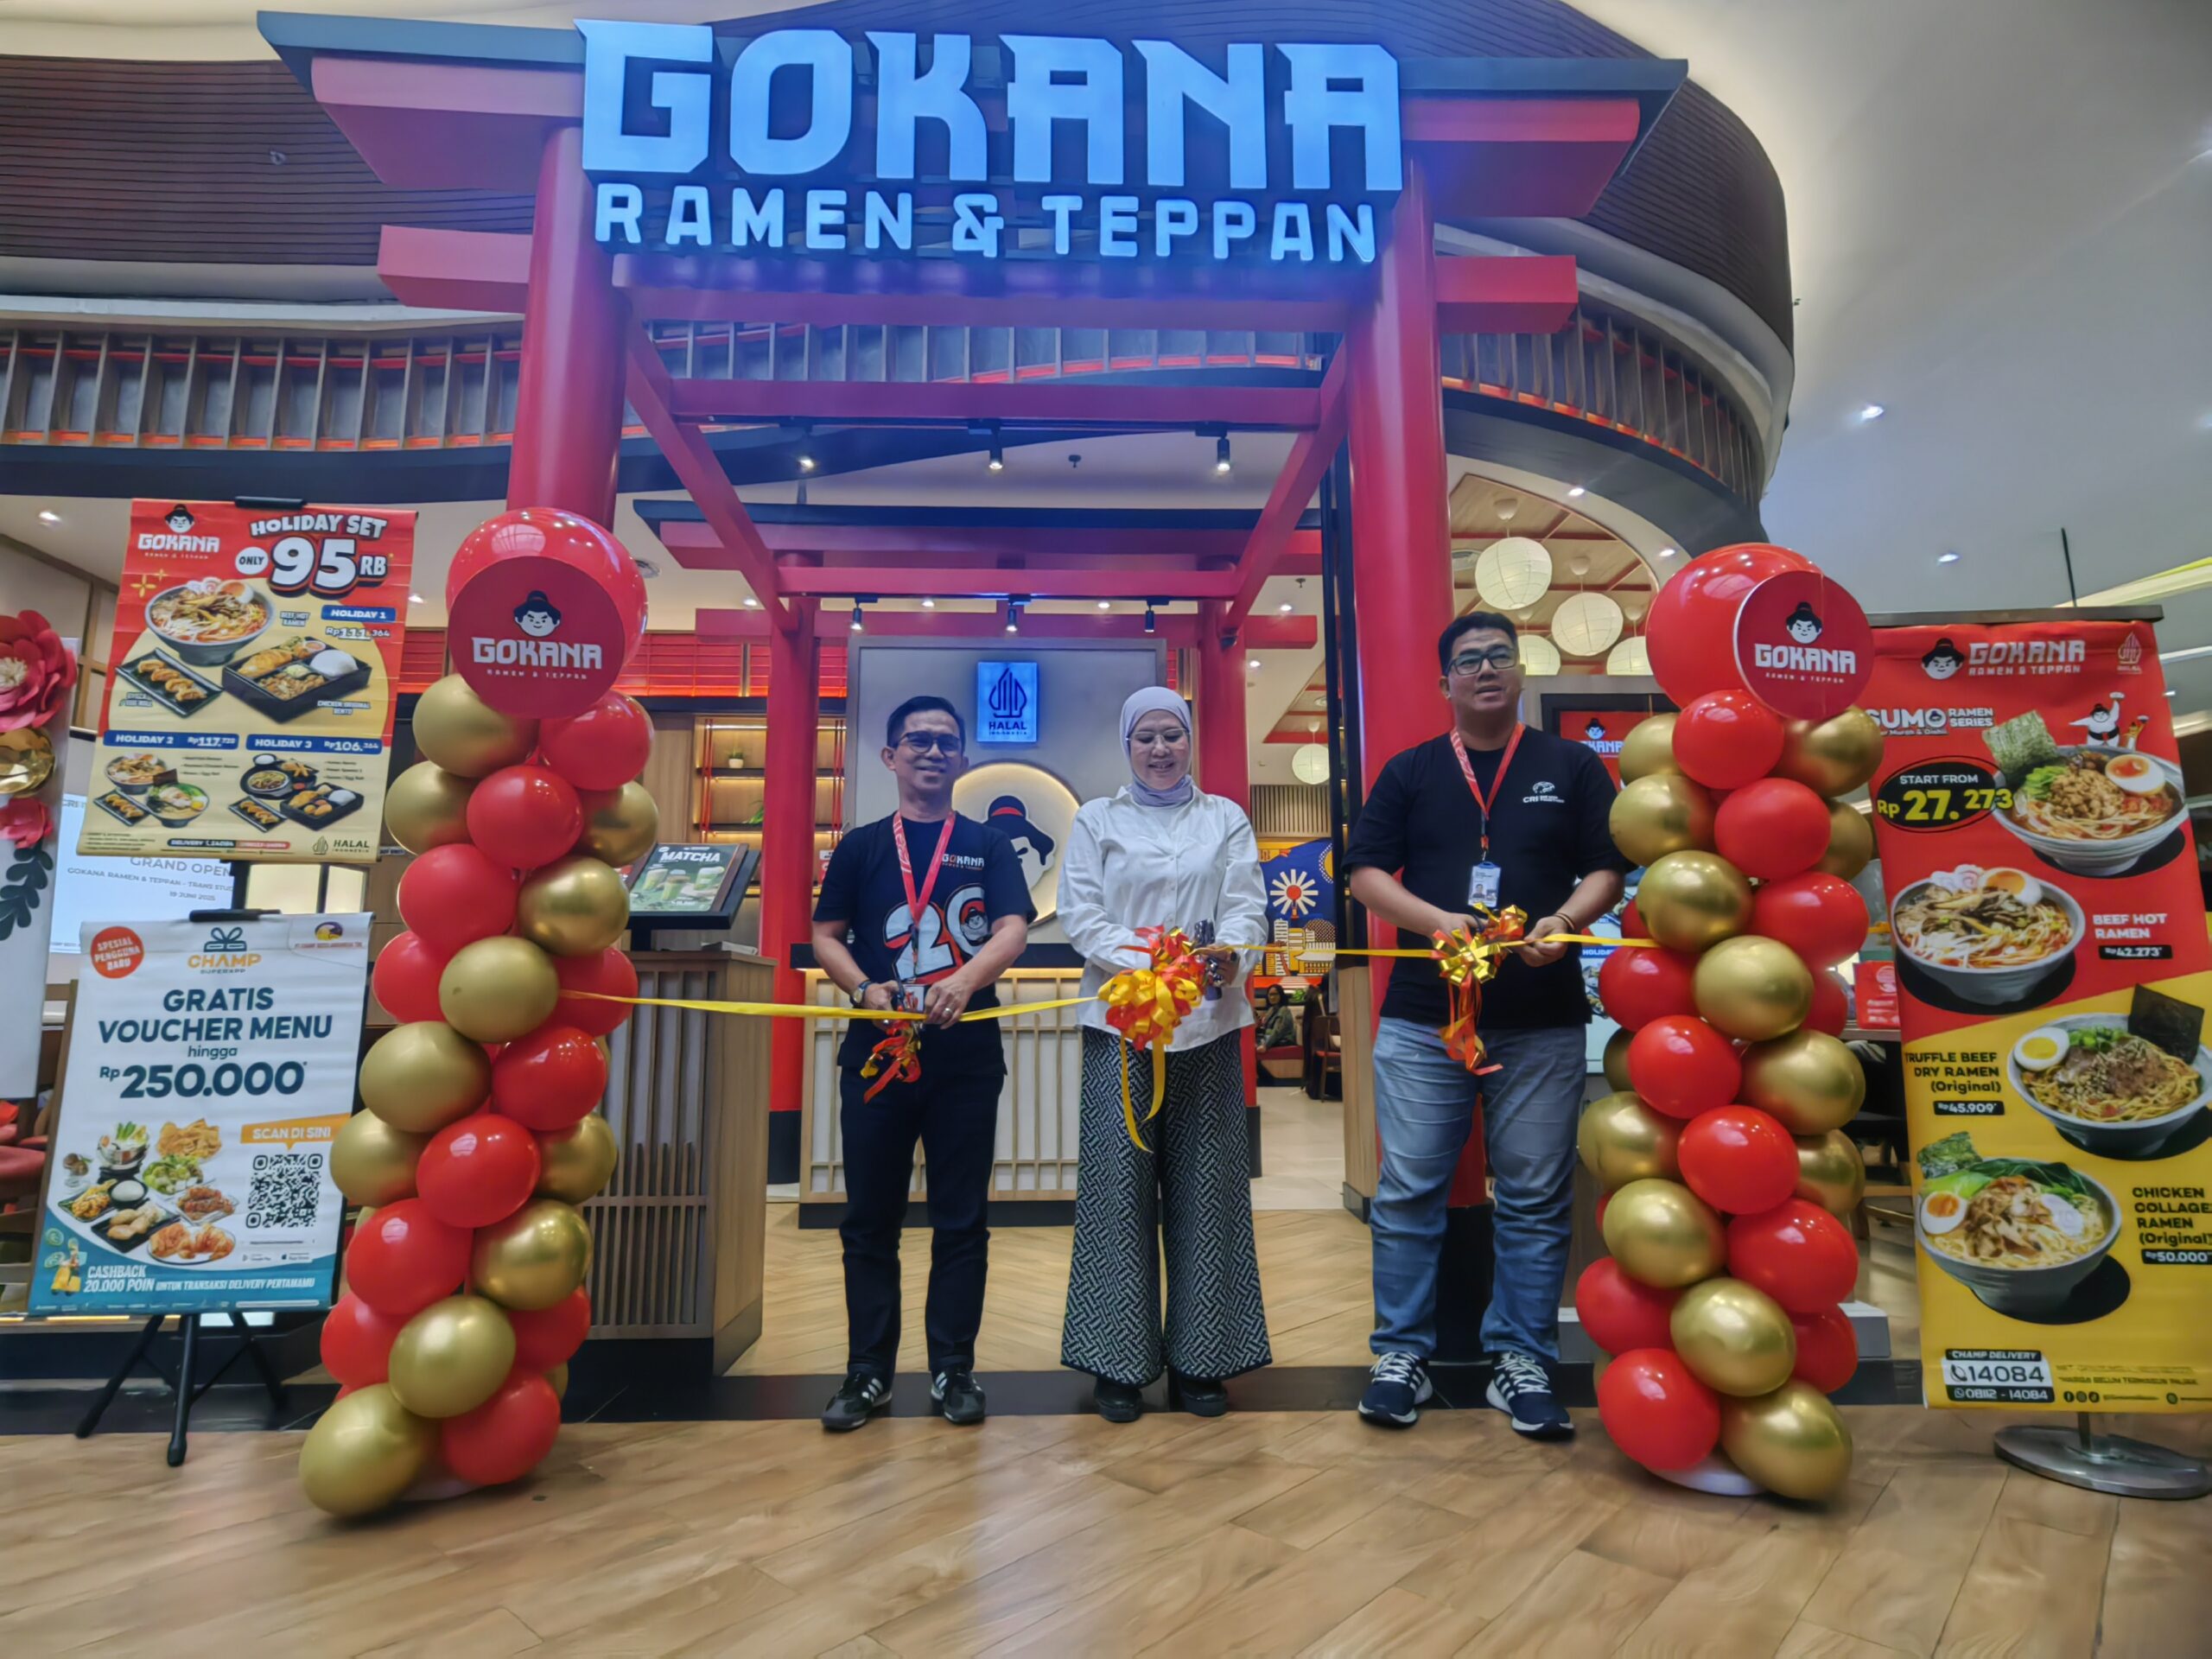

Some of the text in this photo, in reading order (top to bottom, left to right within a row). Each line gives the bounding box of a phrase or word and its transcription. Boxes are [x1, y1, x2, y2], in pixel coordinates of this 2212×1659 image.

[574, 19, 1402, 191] GOKANA
[594, 183, 1376, 263] RAMEN & TEPPAN
[250, 514, 387, 538] HOLIDAY SET
[138, 533, 220, 553] GOKANA
[238, 536, 387, 589] ONLY 95 RB
[331, 609, 378, 618] HOLIDAY
[471, 637, 602, 670] GOKANA
[1968, 640, 2086, 664] GOKANA
[1754, 643, 1856, 675] GOKANA
[1968, 667, 2014, 676] RAMEN
[2031, 664, 2082, 675] TEPPAN
[1948, 708, 1993, 717] RAMEN
[988, 721, 1027, 730] HALAL
[1949, 717, 1993, 728] SERIES
[116, 734, 165, 744] HOLIDAY
[255, 739, 302, 748] HOLIDAY
[305, 740, 312, 749] 3
[1900, 774, 1979, 785] START FROM
[1877, 799, 1900, 818] Rp
[334, 839, 370, 849] HALAL
[659, 851, 721, 862] MATCHA
[942, 854, 985, 868] GOKANA
[130, 856, 188, 872] GRAND
[2093, 913, 2167, 925] BEEF HOT
[2094, 928, 2151, 939] RAMEN
[188, 954, 262, 968] CHAMP
[163, 987, 275, 1012] GRATIS
[98, 1014, 333, 1044] VOUCHER MENU
[188, 1045, 238, 1060] hingga
[1905, 1052, 1997, 1063] TRUFFLE BEEF
[1914, 1066, 1999, 1077] DRY RAMEN
[1930, 1079, 2002, 1095] (Original)
[252, 1127, 332, 1140] SCAN DI SINI
[2133, 1186, 2205, 1198] CHICKEN
[2134, 1202, 2212, 1214] COLLAGE
[2137, 1217, 2194, 1229] RAMEN
[87, 1265, 147, 1279] CASHBACK
[84, 1279, 125, 1293] 20.000
[126, 1278, 156, 1292] POIN
[183, 1281, 228, 1290] TRANSAKSI
[228, 1279, 265, 1290] DELIVERY
[1952, 1350, 2037, 1360] CHAMP DELIVERY
[1967, 1365, 2044, 1382] 14084
[2009, 1389, 2049, 1400] 14084
